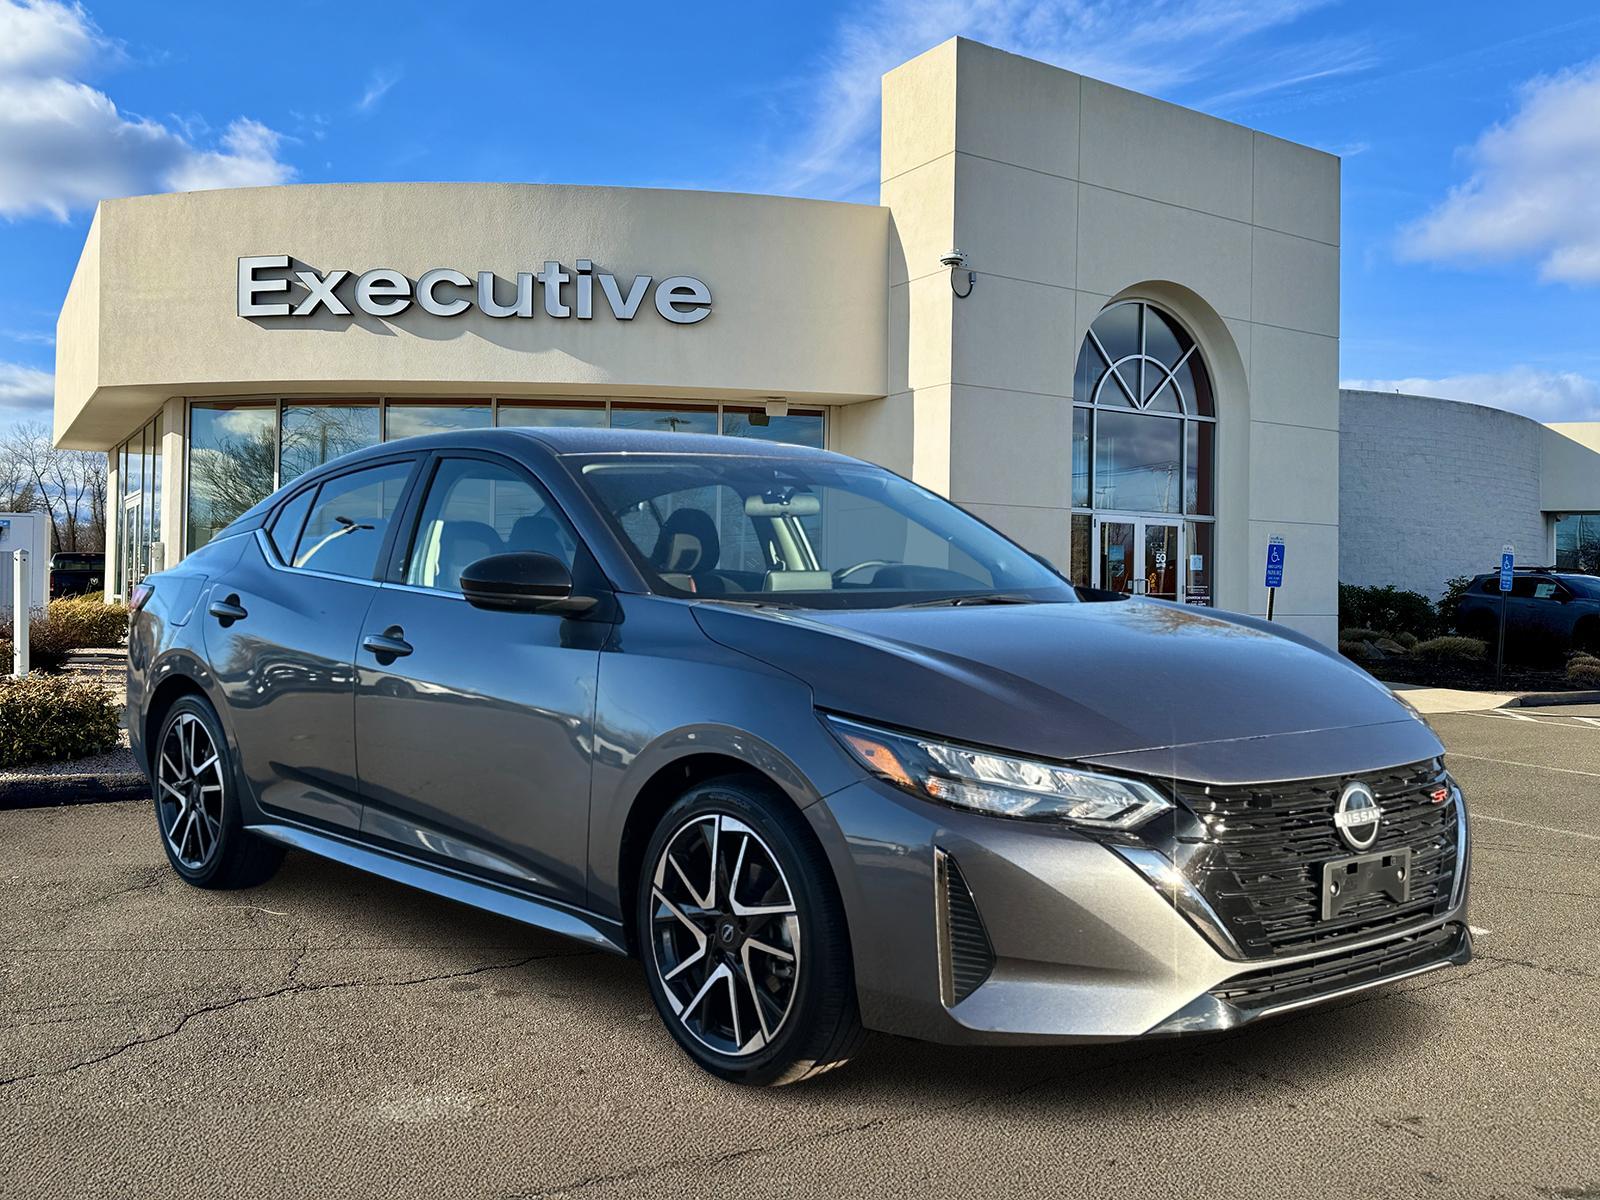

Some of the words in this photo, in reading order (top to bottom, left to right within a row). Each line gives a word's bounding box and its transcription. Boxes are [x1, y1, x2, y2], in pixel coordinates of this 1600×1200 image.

[237, 255, 713, 324] Executive
[1430, 788, 1448, 803] SR
[1341, 808, 1381, 824] NISSAN
